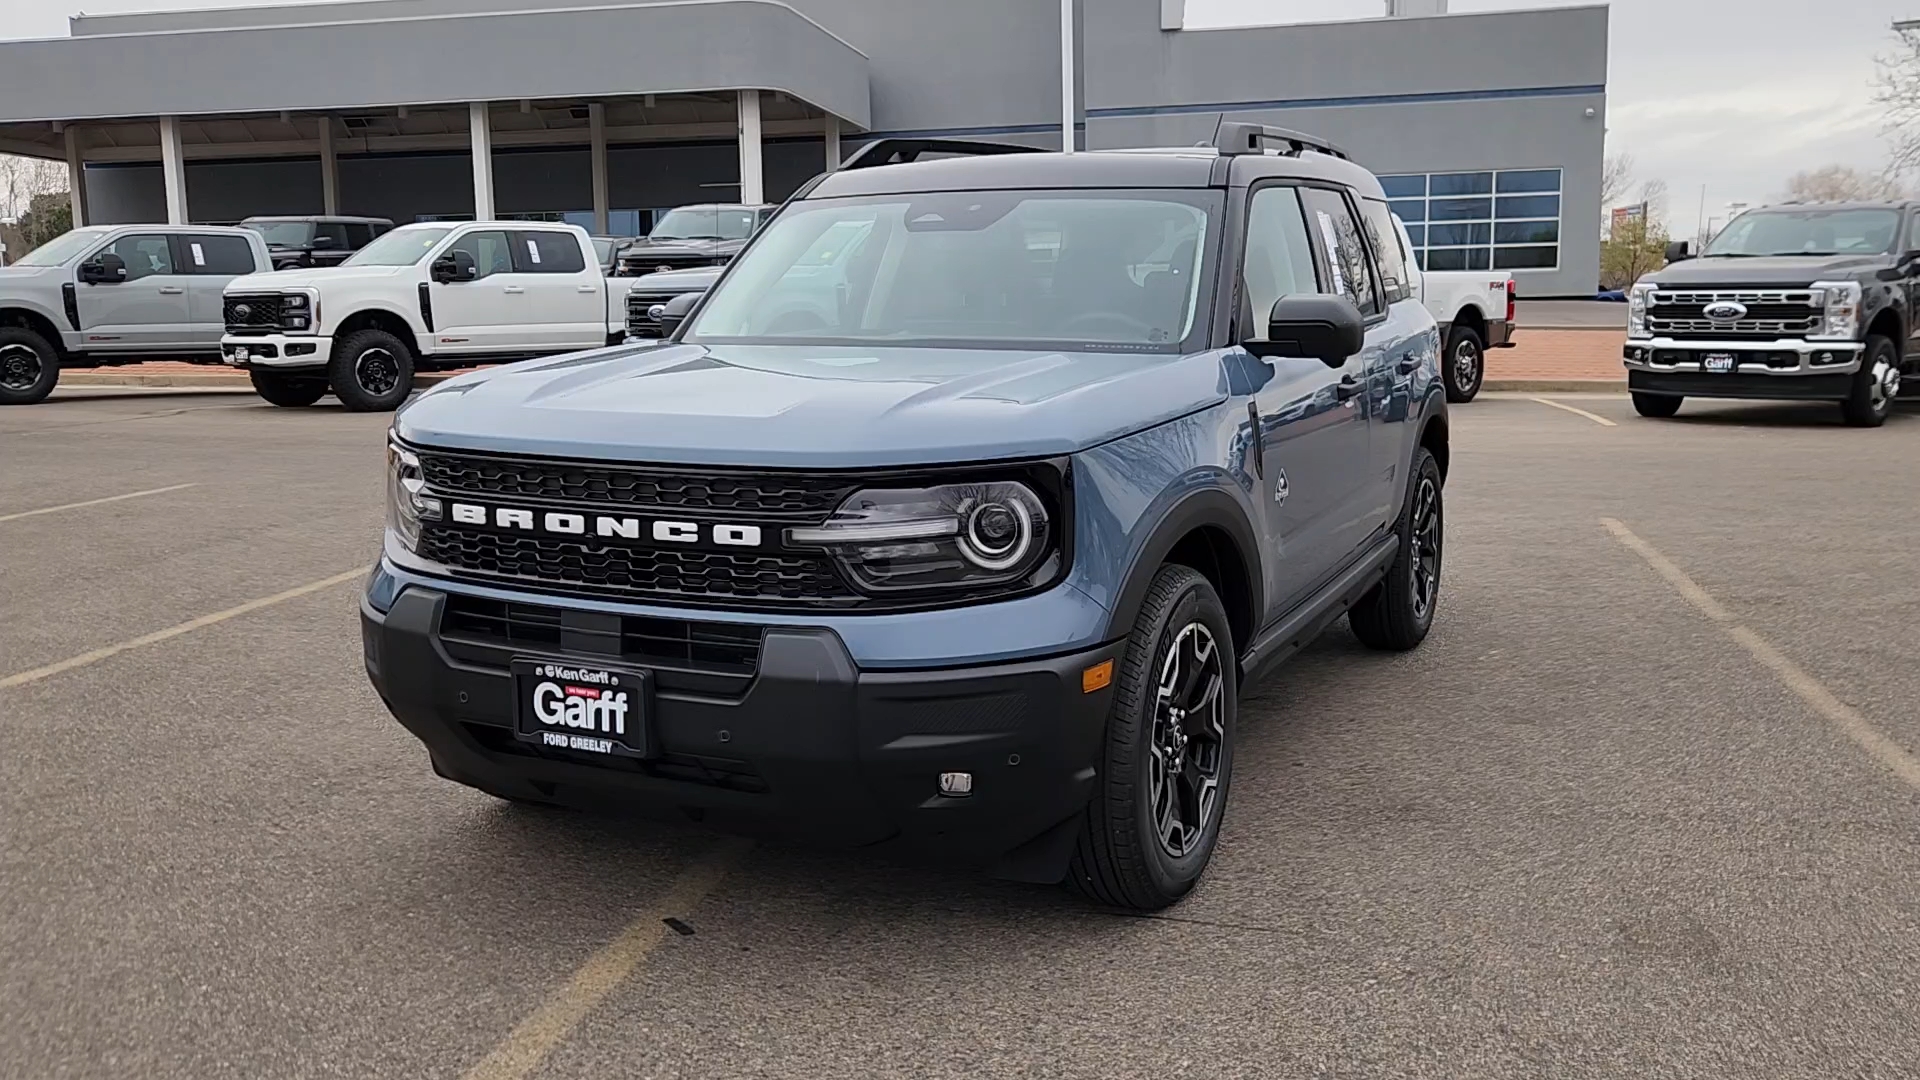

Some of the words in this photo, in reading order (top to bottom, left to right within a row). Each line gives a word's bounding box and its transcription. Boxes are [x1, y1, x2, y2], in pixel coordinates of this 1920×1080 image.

[1705, 357, 1733, 369] Garff
[452, 503, 762, 546] BRONCO
[555, 666, 580, 681] Ken
[579, 669, 609, 684] Garff
[534, 681, 628, 734] Garff
[543, 733, 569, 748] FORD
[570, 737, 612, 754] GREELEY
